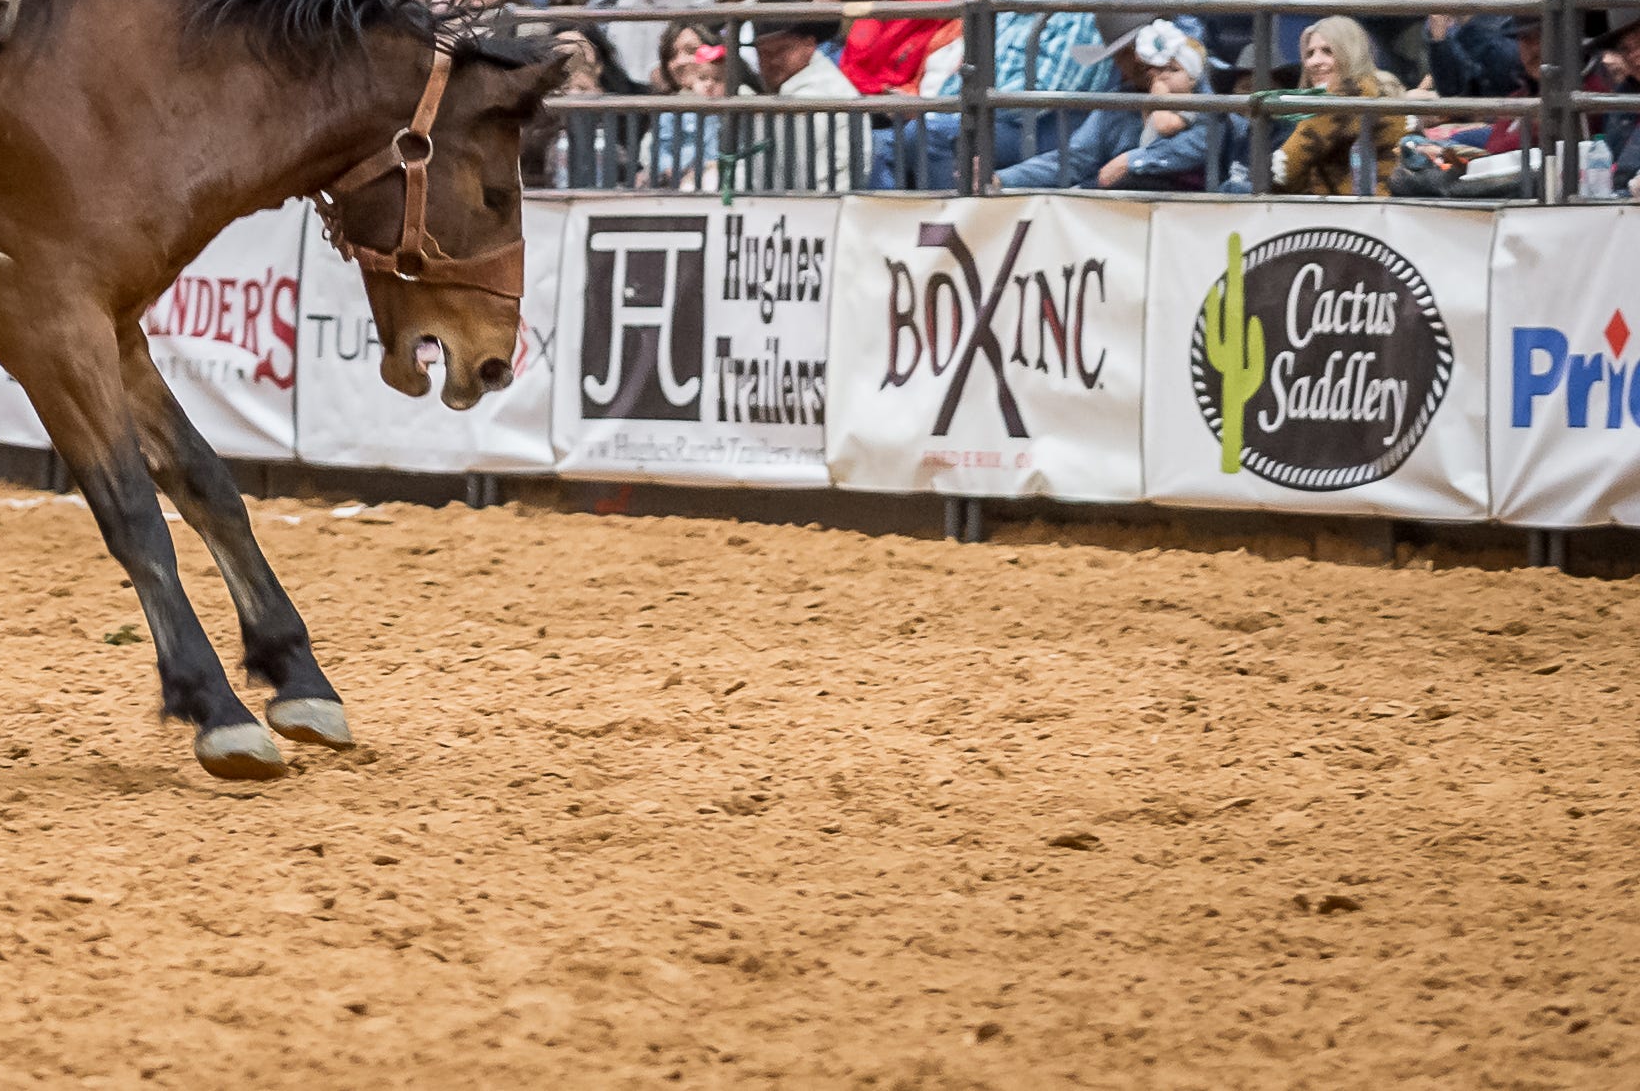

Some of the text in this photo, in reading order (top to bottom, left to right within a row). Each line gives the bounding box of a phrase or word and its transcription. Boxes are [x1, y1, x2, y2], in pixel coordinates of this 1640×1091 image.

[723, 213, 825, 325] Hughes
[1286, 262, 1398, 348] Cactus
[715, 336, 827, 425] Trailers
[1257, 350, 1408, 447] Saddlery
